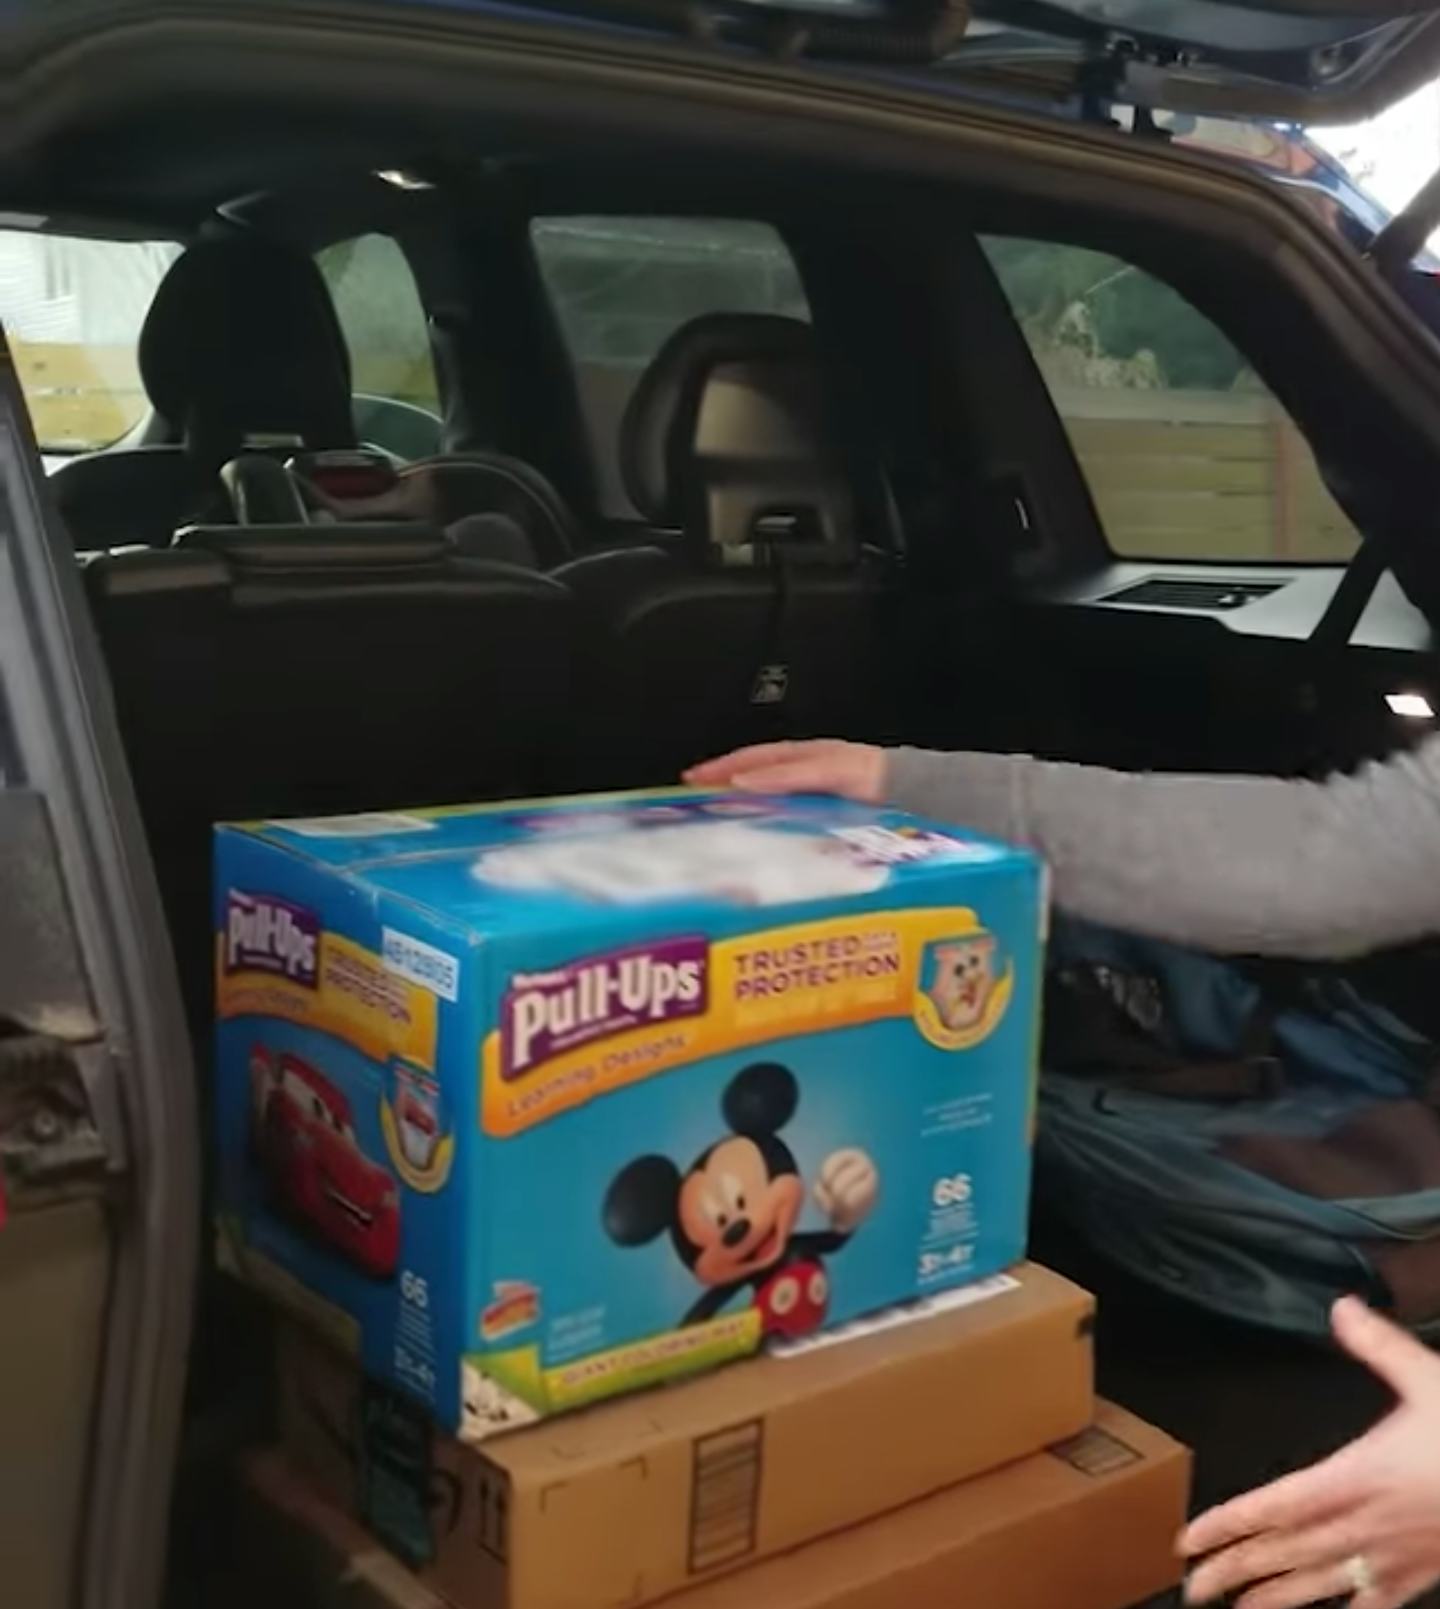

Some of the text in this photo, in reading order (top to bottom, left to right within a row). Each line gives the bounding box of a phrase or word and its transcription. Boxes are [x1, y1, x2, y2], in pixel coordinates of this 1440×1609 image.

[228, 902, 315, 976] Pull-Ups
[734, 934, 860, 976] TRUSTED
[735, 952, 900, 1001] PROTECTION
[511, 954, 703, 1070] Pull-Ups
[933, 1172, 973, 1207] 66
[401, 1269, 429, 1309] 66
